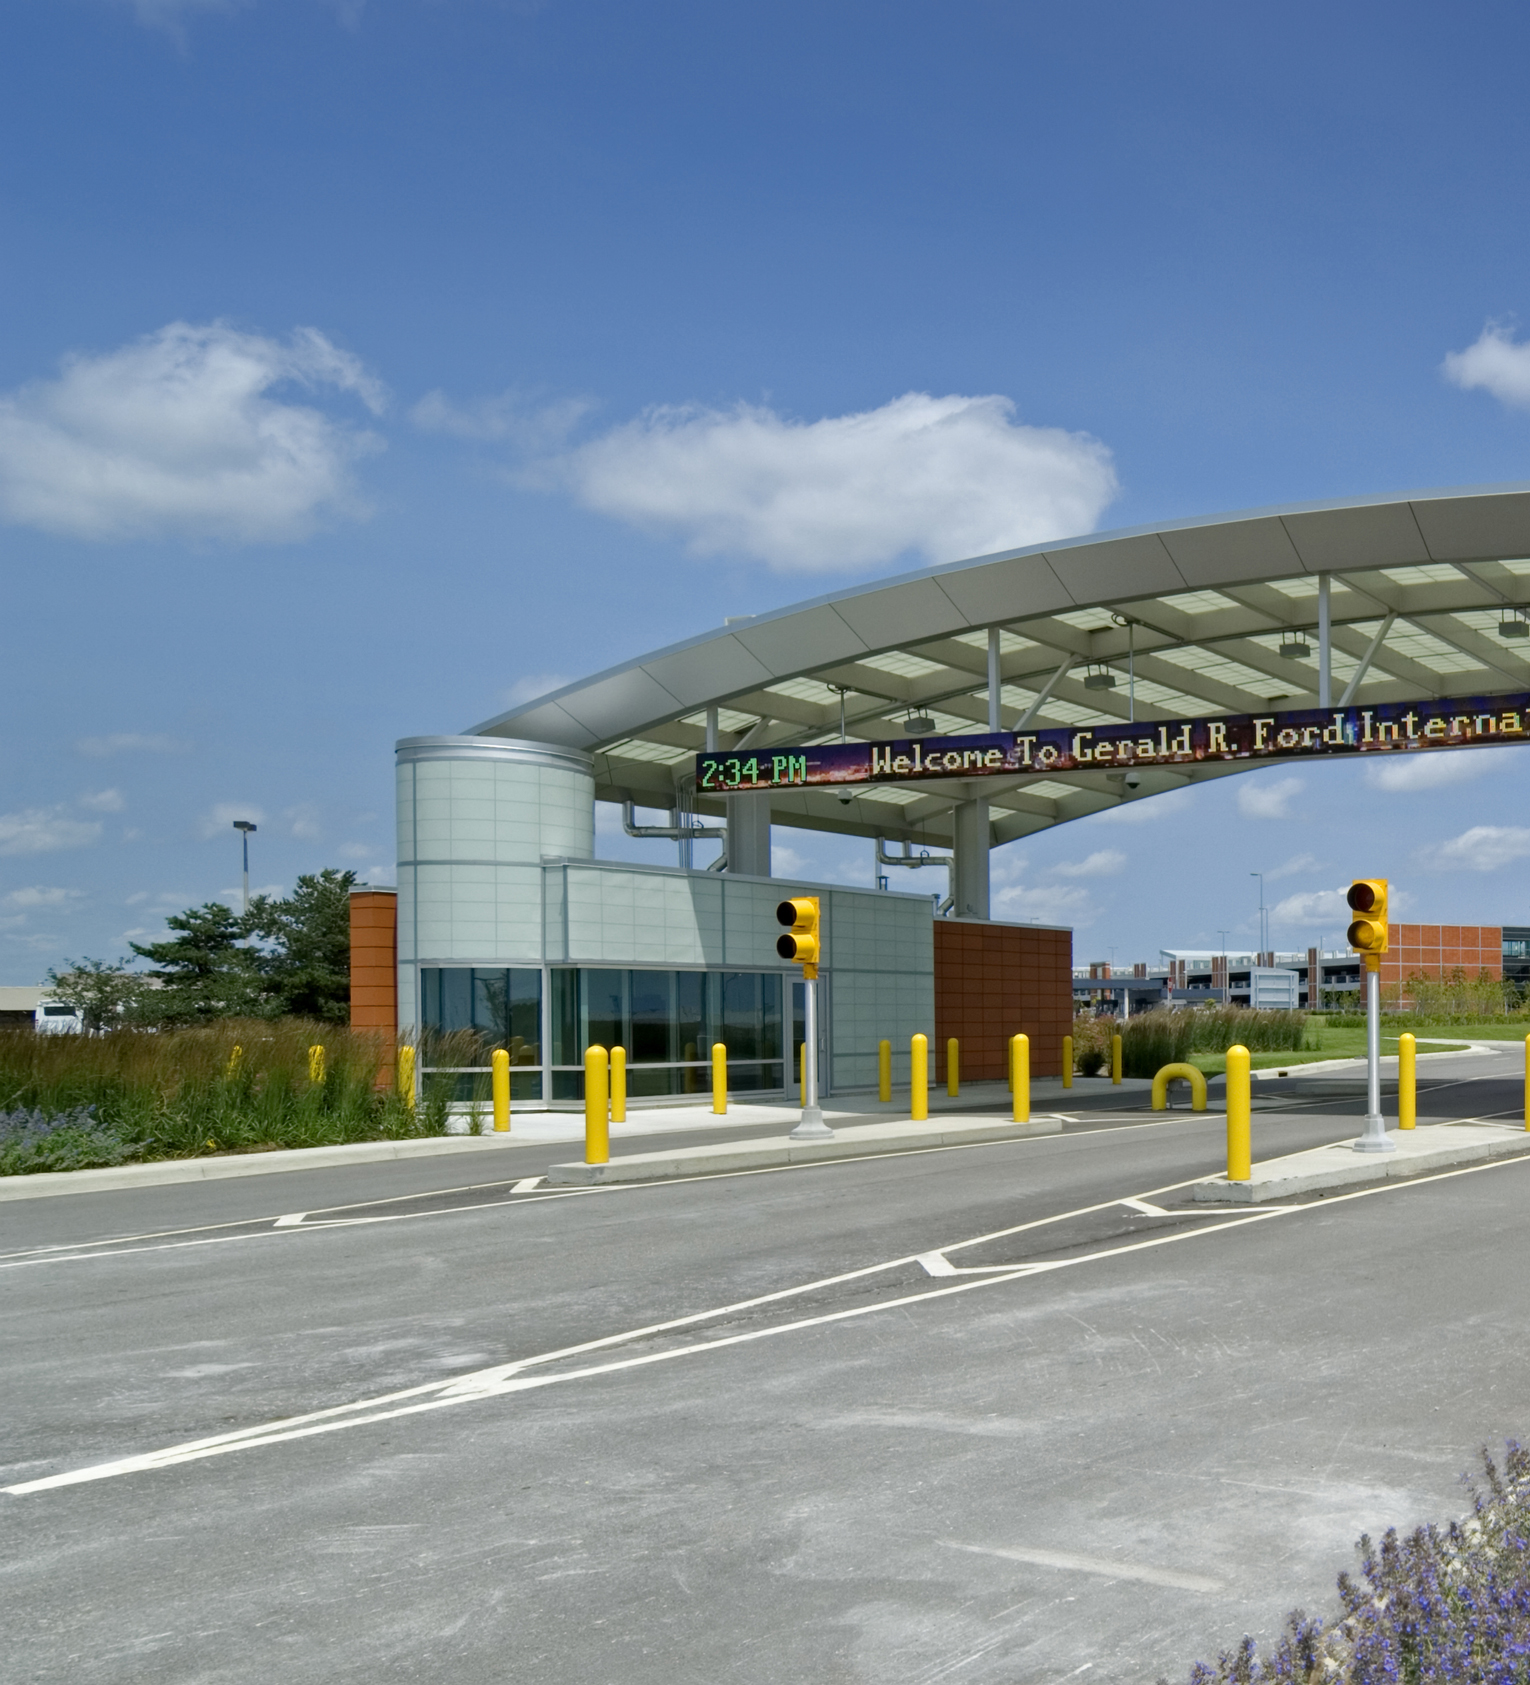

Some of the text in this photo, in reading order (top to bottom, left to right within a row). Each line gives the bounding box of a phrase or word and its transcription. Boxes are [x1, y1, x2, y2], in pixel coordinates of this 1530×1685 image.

[872, 744, 1003, 775] Welcome
[1017, 736, 1058, 765] To
[1072, 725, 1192, 762] Gerald
[1207, 722, 1238, 752] R.
[1253, 713, 1346, 750] Ford
[702, 755, 807, 787] 2:34 PM
